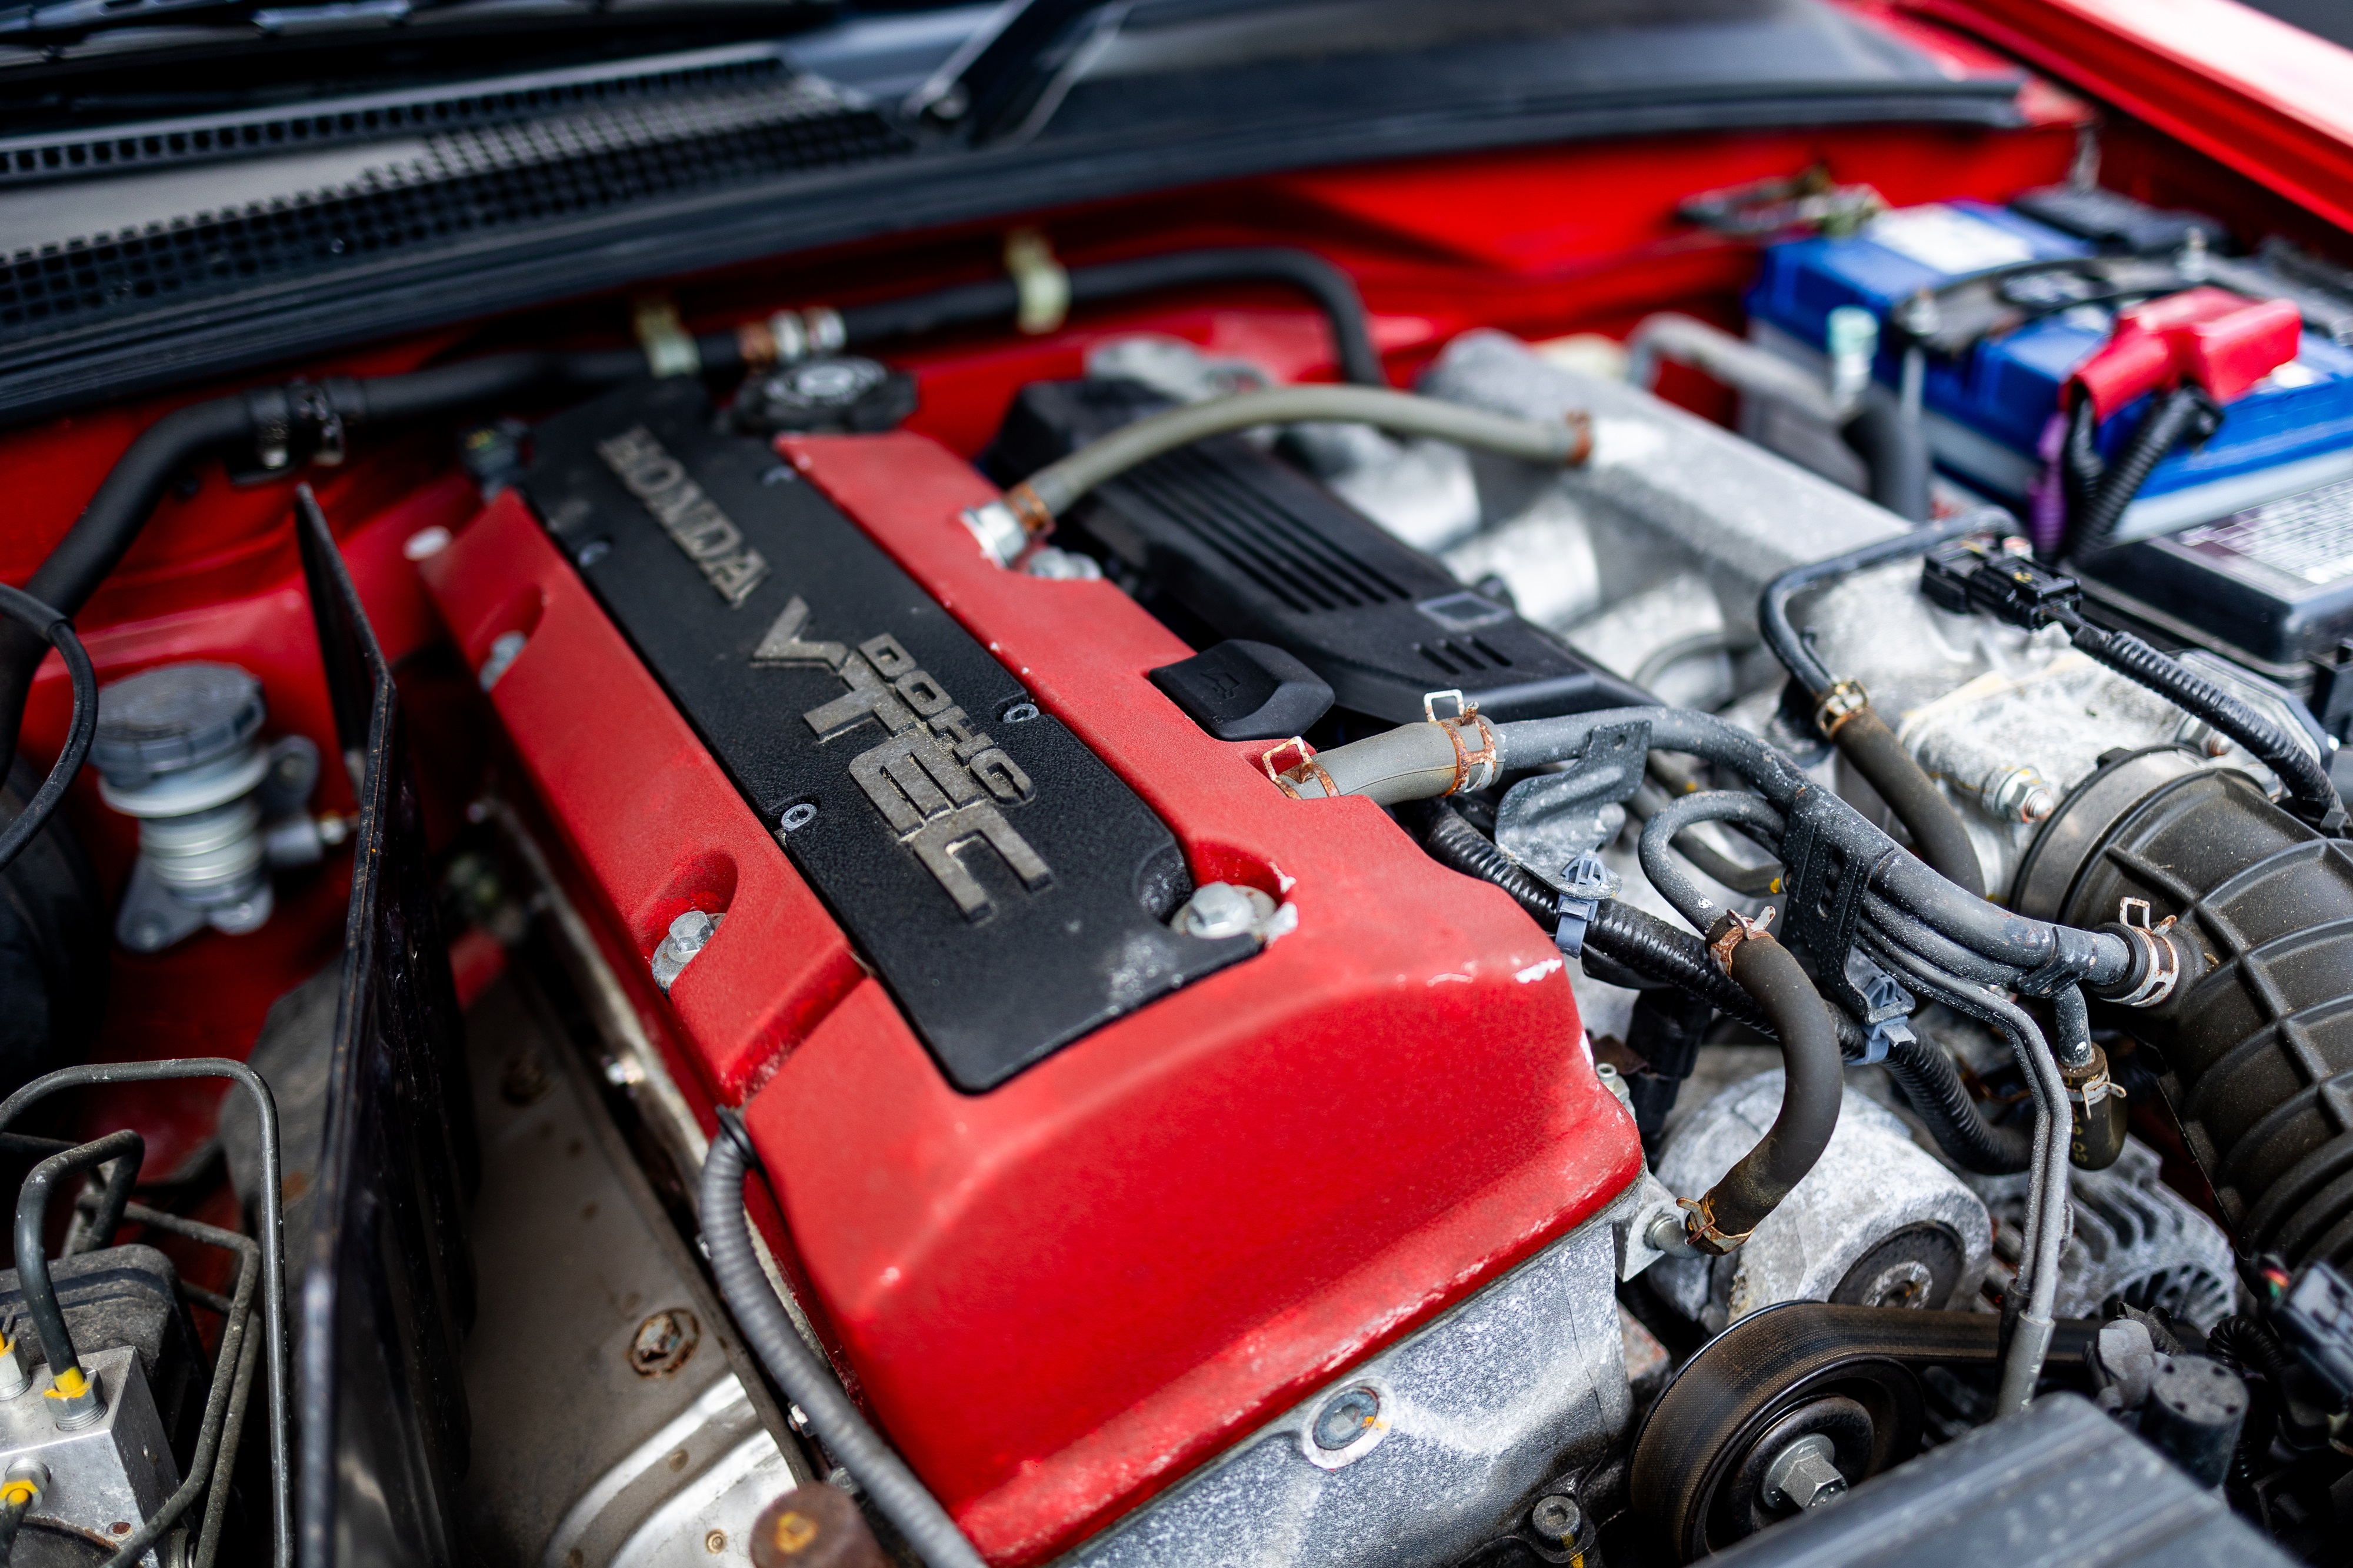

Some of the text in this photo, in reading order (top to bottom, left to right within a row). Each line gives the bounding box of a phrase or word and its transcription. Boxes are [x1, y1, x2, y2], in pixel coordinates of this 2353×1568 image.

[596, 423, 768, 608] HONDA
[752, 594, 1051, 922] VTEC
[858, 633, 1035, 805] DOHC
